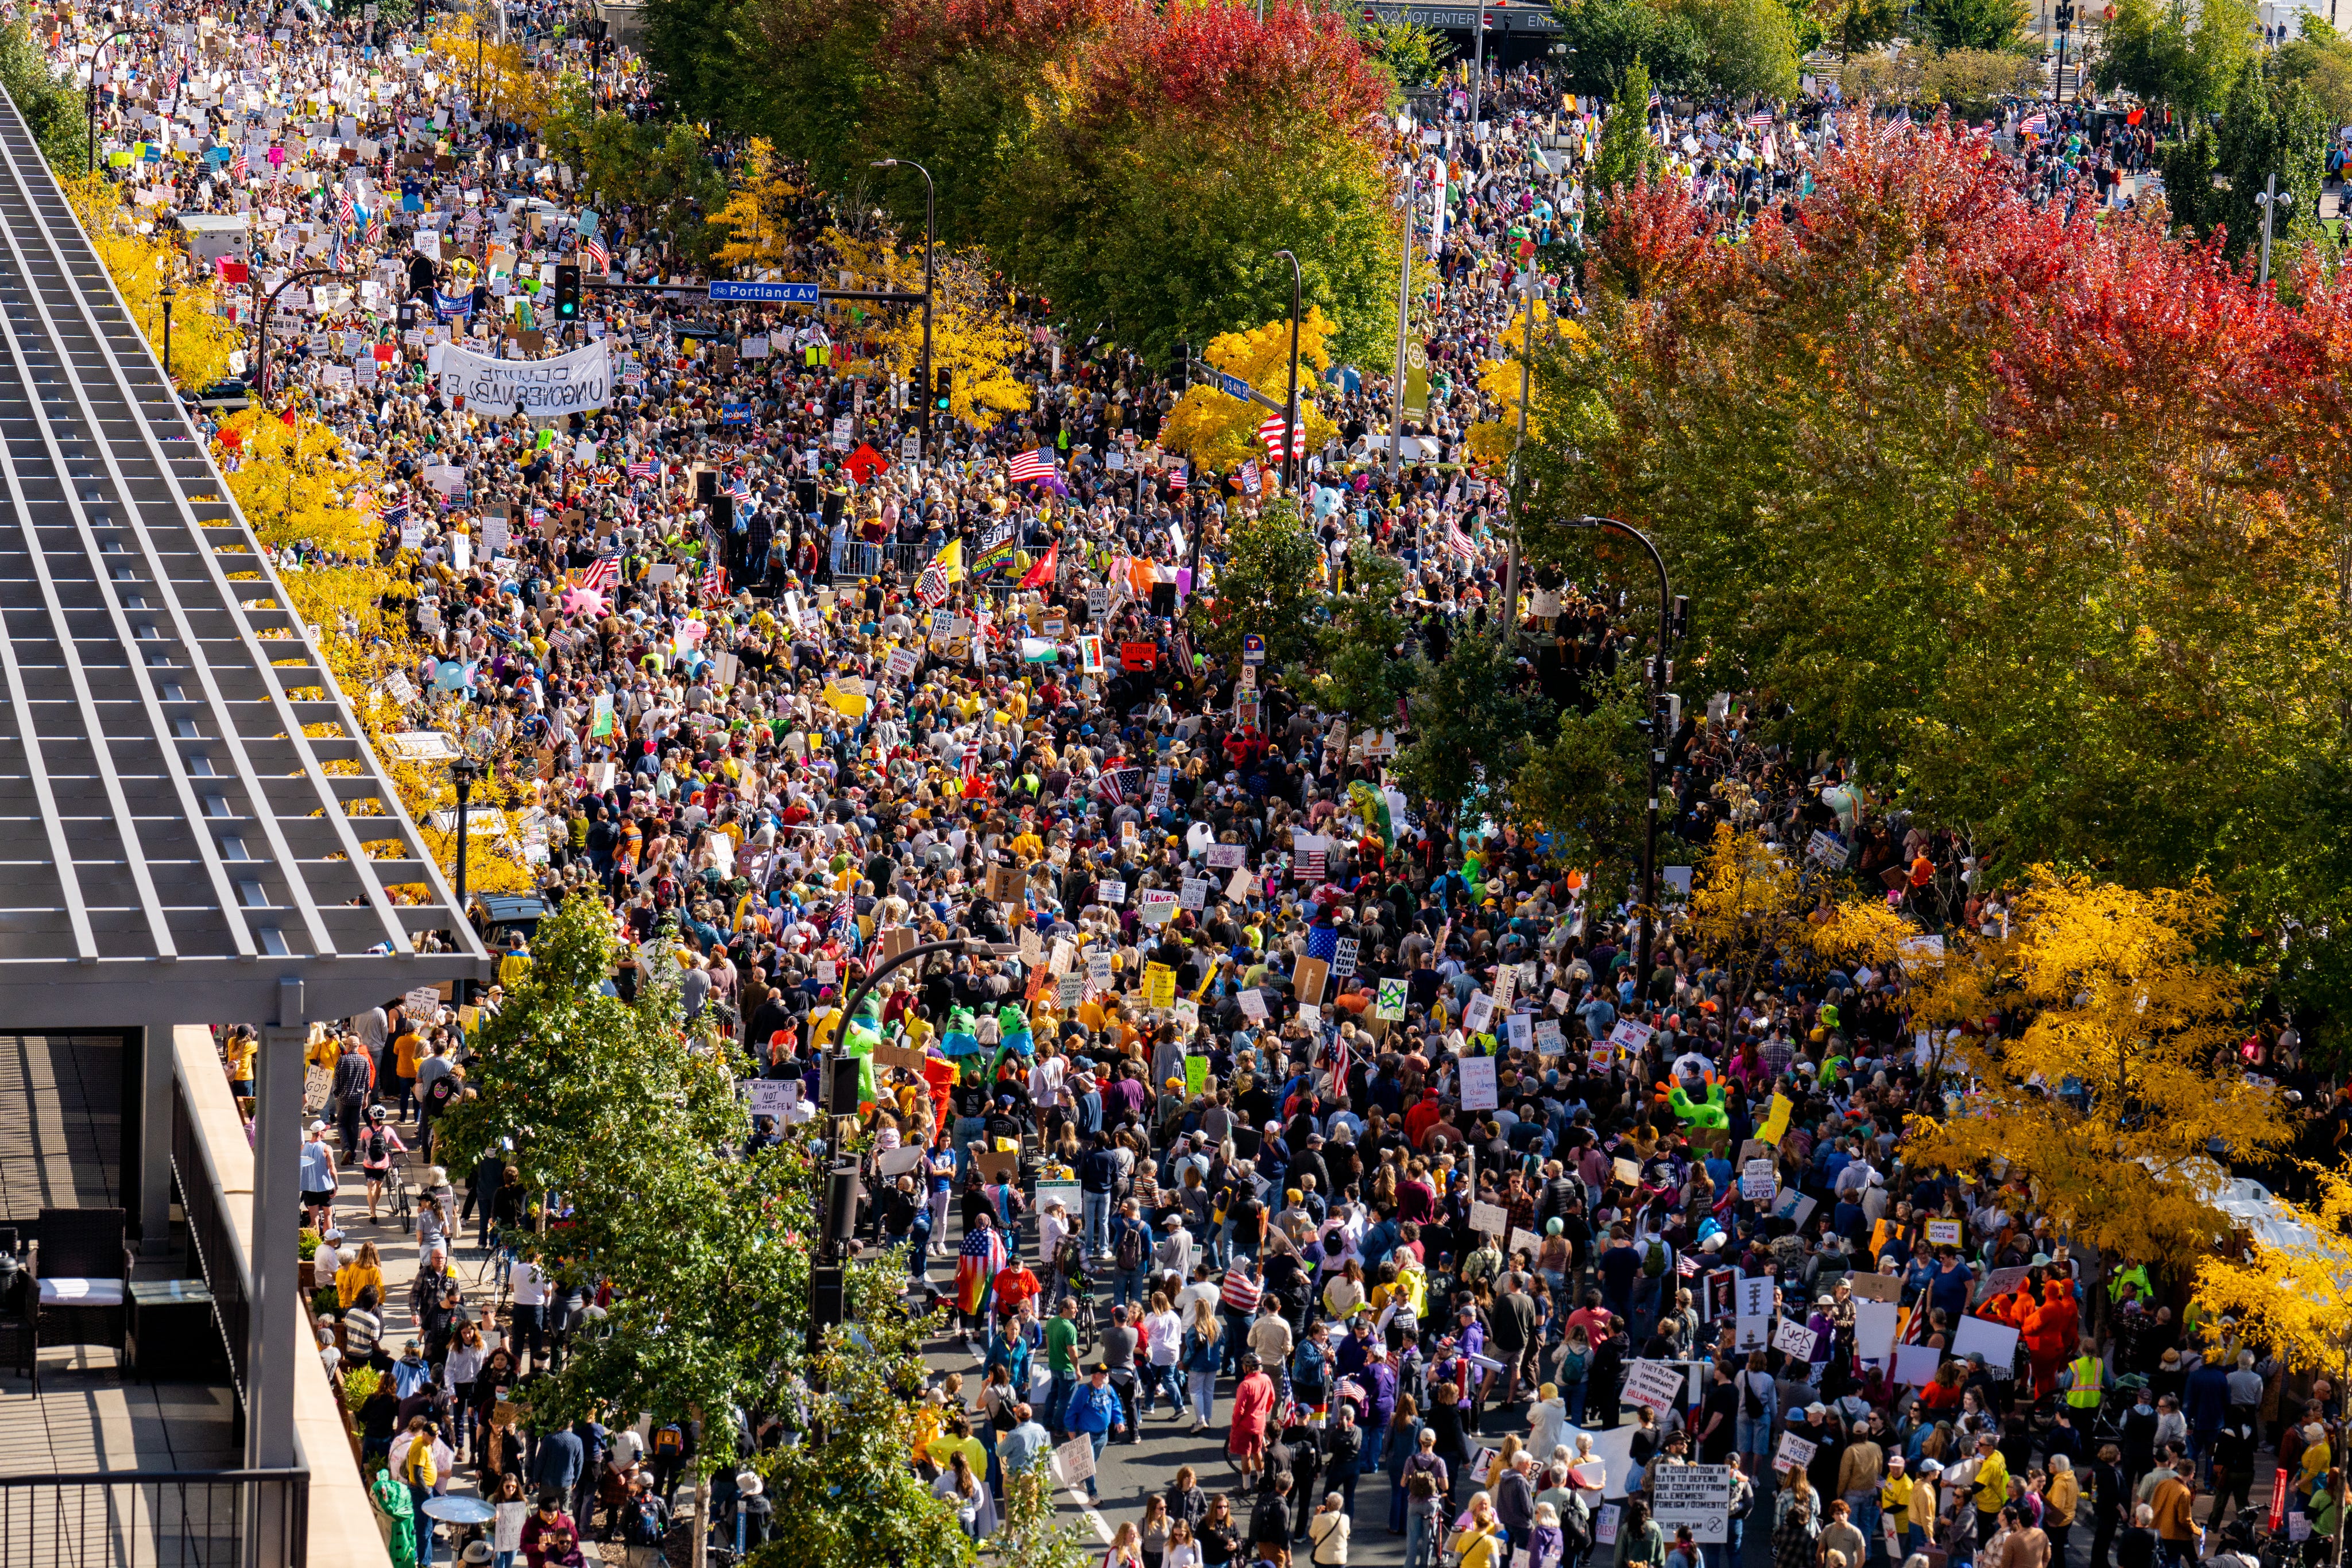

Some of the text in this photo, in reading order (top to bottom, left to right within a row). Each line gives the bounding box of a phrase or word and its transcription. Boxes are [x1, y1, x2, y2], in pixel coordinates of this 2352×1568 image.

[1382, 11, 1475, 25] DO NOT ENTER
[730, 286, 815, 299] Portland Av
[467, 346, 484, 354] KINGS
[1229, 380, 1248, 398] S 4th St
[1532, 605, 1558, 615] TRUMP
[552, 633, 568, 645] 8647
[1125, 646, 1153, 655] DETOUR
[893, 657, 911, 668] WRONG
[902, 652, 918, 663] LYING
[892, 664, 908, 673] AGAIN
[1154, 794, 1166, 802] NO
[1145, 893, 1174, 902] I LOVE
[1023, 931, 1040, 946] SAVE
[1024, 943, 1036, 954] OUR
[1341, 939, 1359, 950] NO
[1338, 950, 1358, 959] FAUX
[1336, 958, 1356, 967] KING
[1336, 966, 1353, 975] WAY
[1508, 969, 1518, 980] NO
[1380, 979, 1403, 989] NO
[1503, 981, 1517, 1008] KINGS
[1301, 1006, 1318, 1015] TRUTH
[1379, 1008, 1405, 1020] KINGS
[1618, 1018, 1648, 1038] VETO THE
[1539, 1038, 1557, 1047] LOVE
[1615, 1038, 1637, 1052] CHEETO
[1539, 1046, 1550, 1054] THIS
[876, 1050, 890, 1062] NO
[1189, 1059, 1201, 1068] YOU
[310, 1067, 328, 1082] HEY
[307, 1082, 327, 1093] GOP
[777, 1082, 794, 1091] FREE
[1476, 1082, 1497, 1090] Kidnapping
[763, 1091, 777, 1100] NOT
[776, 1102, 792, 1110] FEW
[1748, 1162, 1772, 1170] criticize
[1758, 1170, 1773, 1178] Trump
[1743, 1188, 1774, 1198] Women
[1524, 1232, 1535, 1240] ONE
[1782, 1324, 1813, 1345] FUCK
[1781, 1338, 1807, 1357] ICE
[1641, 1362, 1678, 1383] THEY BLAME
[1629, 1379, 1650, 1392] SO YOU
[1639, 1372, 1673, 1391] IMMIGRANTS
[1627, 1389, 1666, 1411] BILLIONAIRES
[1788, 1435, 1811, 1449] NO ONE
[1789, 1447, 1809, 1459] FREE
[1659, 1466, 1727, 1474] IN 2003 TOOK AN
[1655, 1475, 1719, 1483] OATH TO DEFEND
[1655, 1484, 1727, 1492] OUR COUNTRY FROM
[1655, 1492, 1669, 1500] ALL
[1655, 1500, 1728, 1510] FOREIGN/DOMESTIC
[501, 1505, 524, 1517] Kings
[498, 1516, 519, 1527] FALL
[1666, 1521, 1703, 1530] HERE AM
[497, 1526, 524, 1537] PEOPLE
[498, 1536, 523, 1551] RISE
